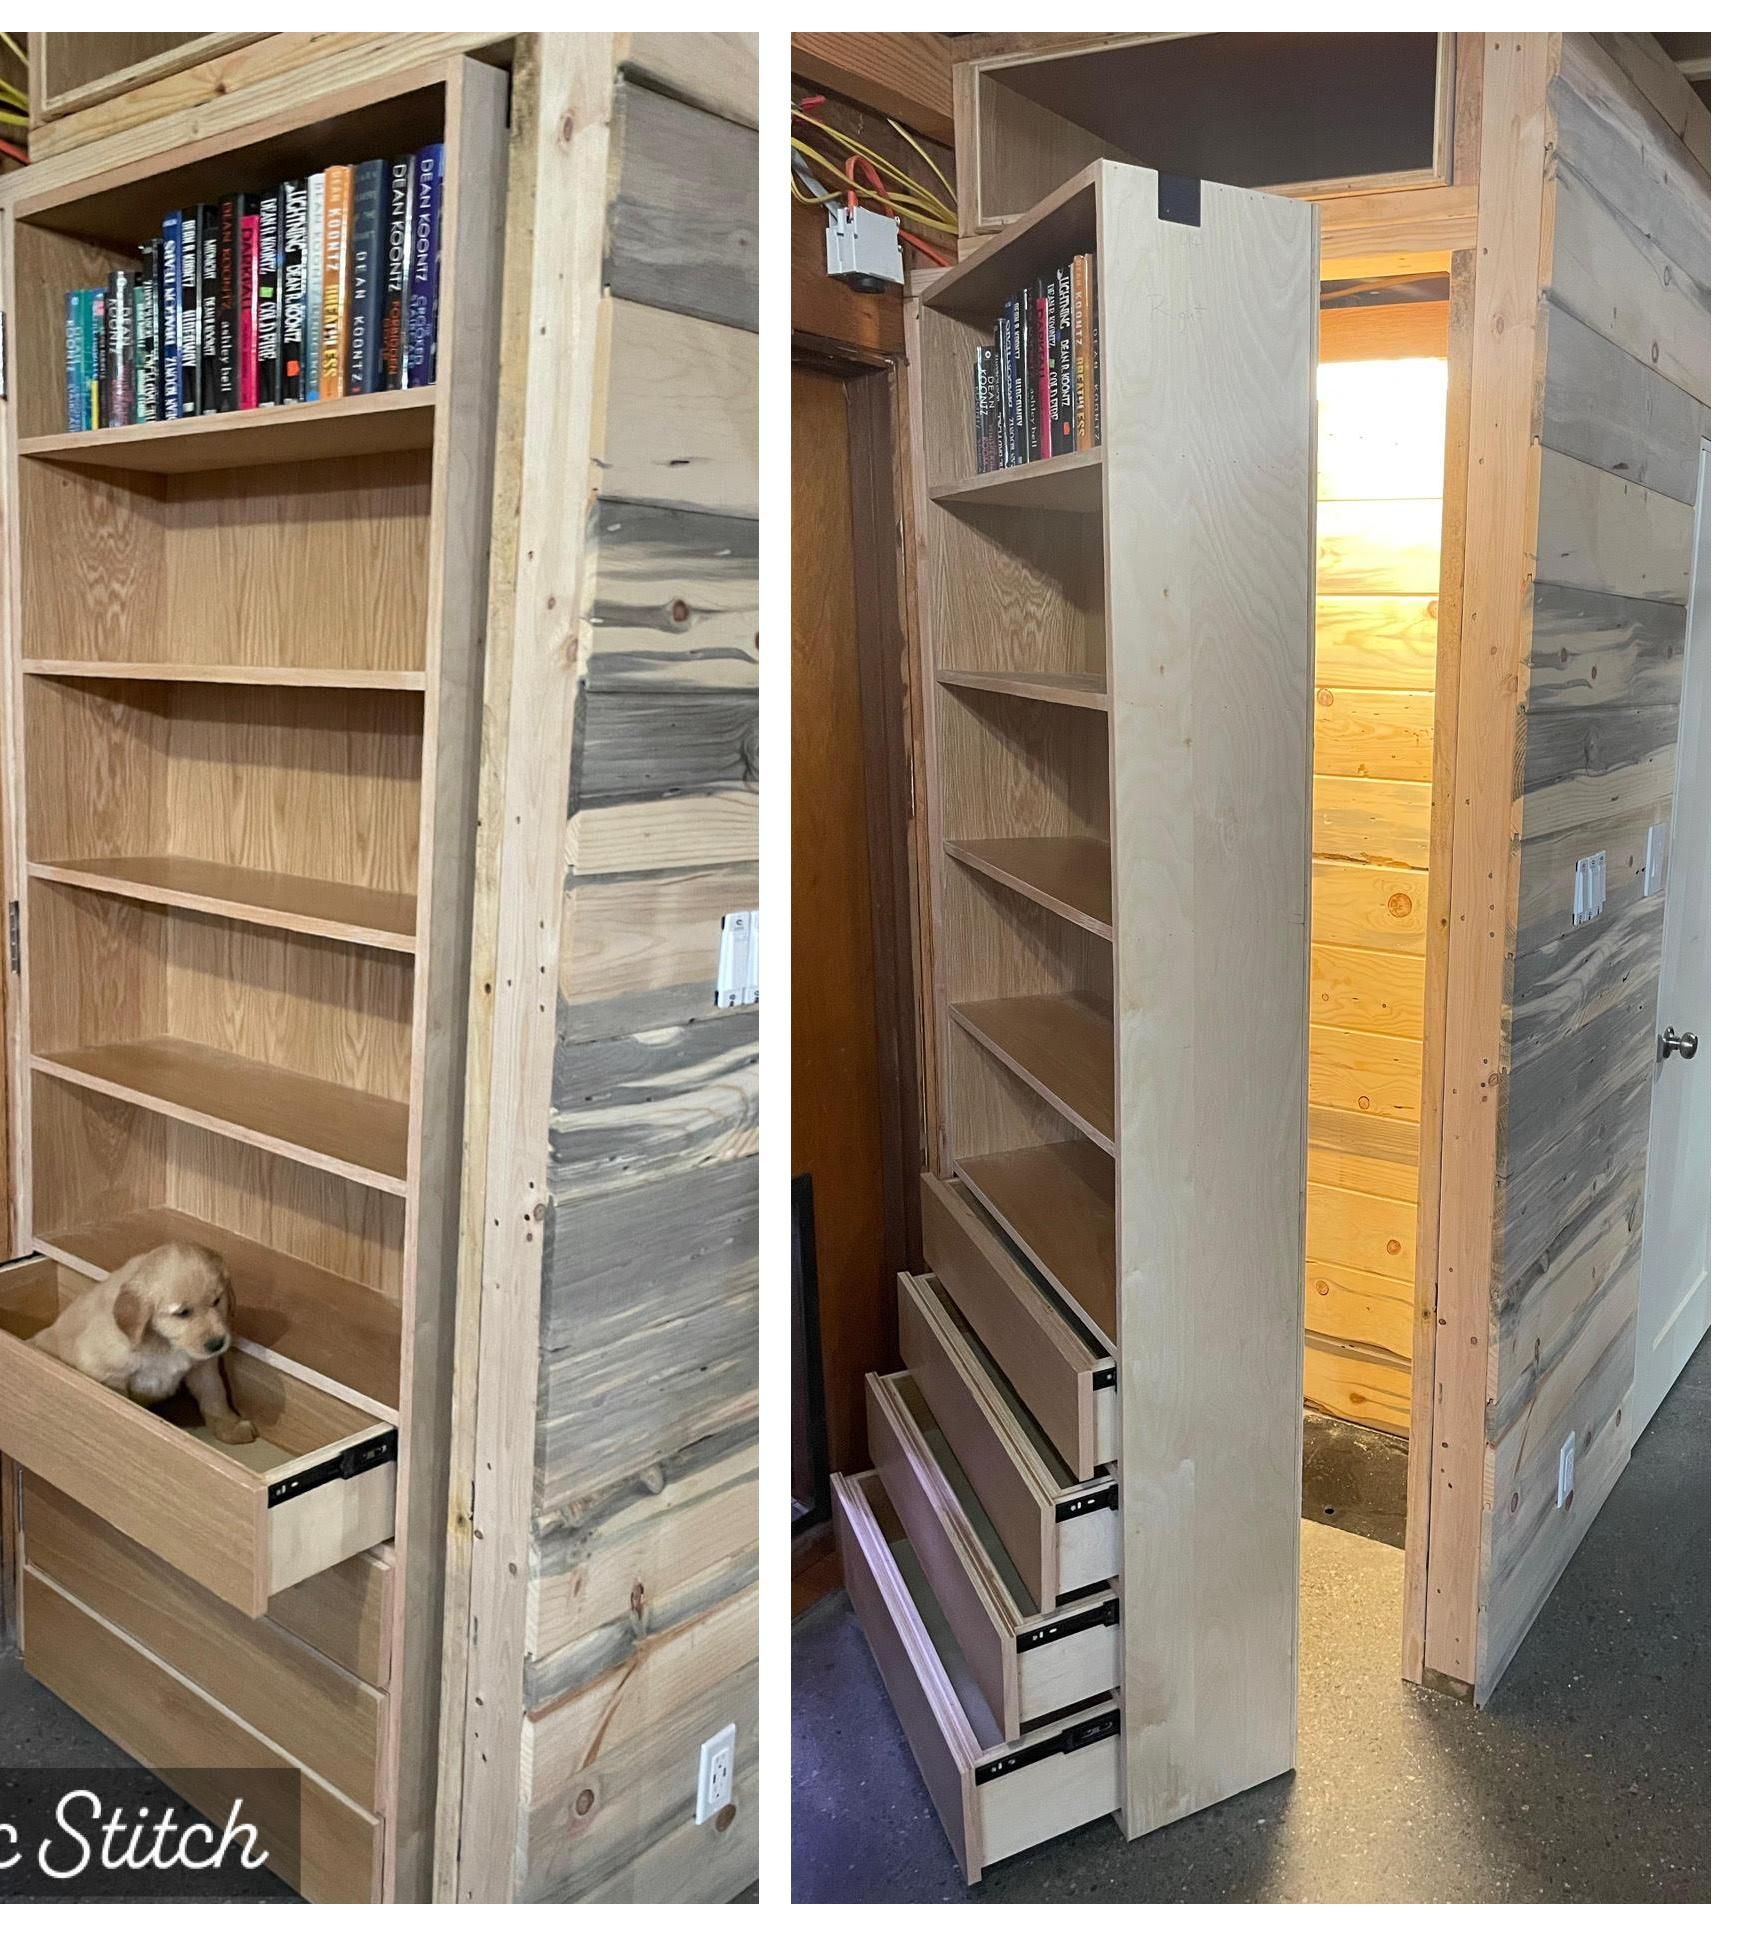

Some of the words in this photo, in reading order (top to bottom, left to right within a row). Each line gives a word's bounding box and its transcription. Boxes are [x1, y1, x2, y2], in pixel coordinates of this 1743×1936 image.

[391, 164, 407, 216] DEAN
[419, 158, 434, 209] DEAN
[260, 197, 277, 225] DEAN
[286, 188, 307, 253] LIGHTNING
[258, 236, 276, 275] KOONTZ
[326, 207, 339, 272] KOONTZ
[387, 220, 403, 292] KOONTZ
[414, 213, 431, 281] KOONTZ
[285, 264, 302, 292] DEAN
[354, 251, 368, 300] DEAN
[164, 287, 177, 347] DRAGON
[259, 301, 277, 332] COLD
[284, 303, 301, 344] KOONTZ
[1058, 275, 1070, 329] LIGHTNING
[1075, 291, 1084, 346] KOONTZ
[219, 320, 232, 363] ashley
[258, 332, 277, 362] FIRE
[322, 283, 338, 378] BREATHLESS
[351, 315, 365, 383] KOONTZ
[387, 299, 400, 376] FORBIDDEN
[415, 295, 428, 366] CROOKED
[1060, 339, 1070, 363] DEAN
[220, 367, 232, 391] bell
[979, 369, 988, 416] KOONTZ
[987, 375, 995, 409] DEAN
[1060, 372, 1070, 407] KOONTZ
[1028, 388, 1037, 424] ashley
